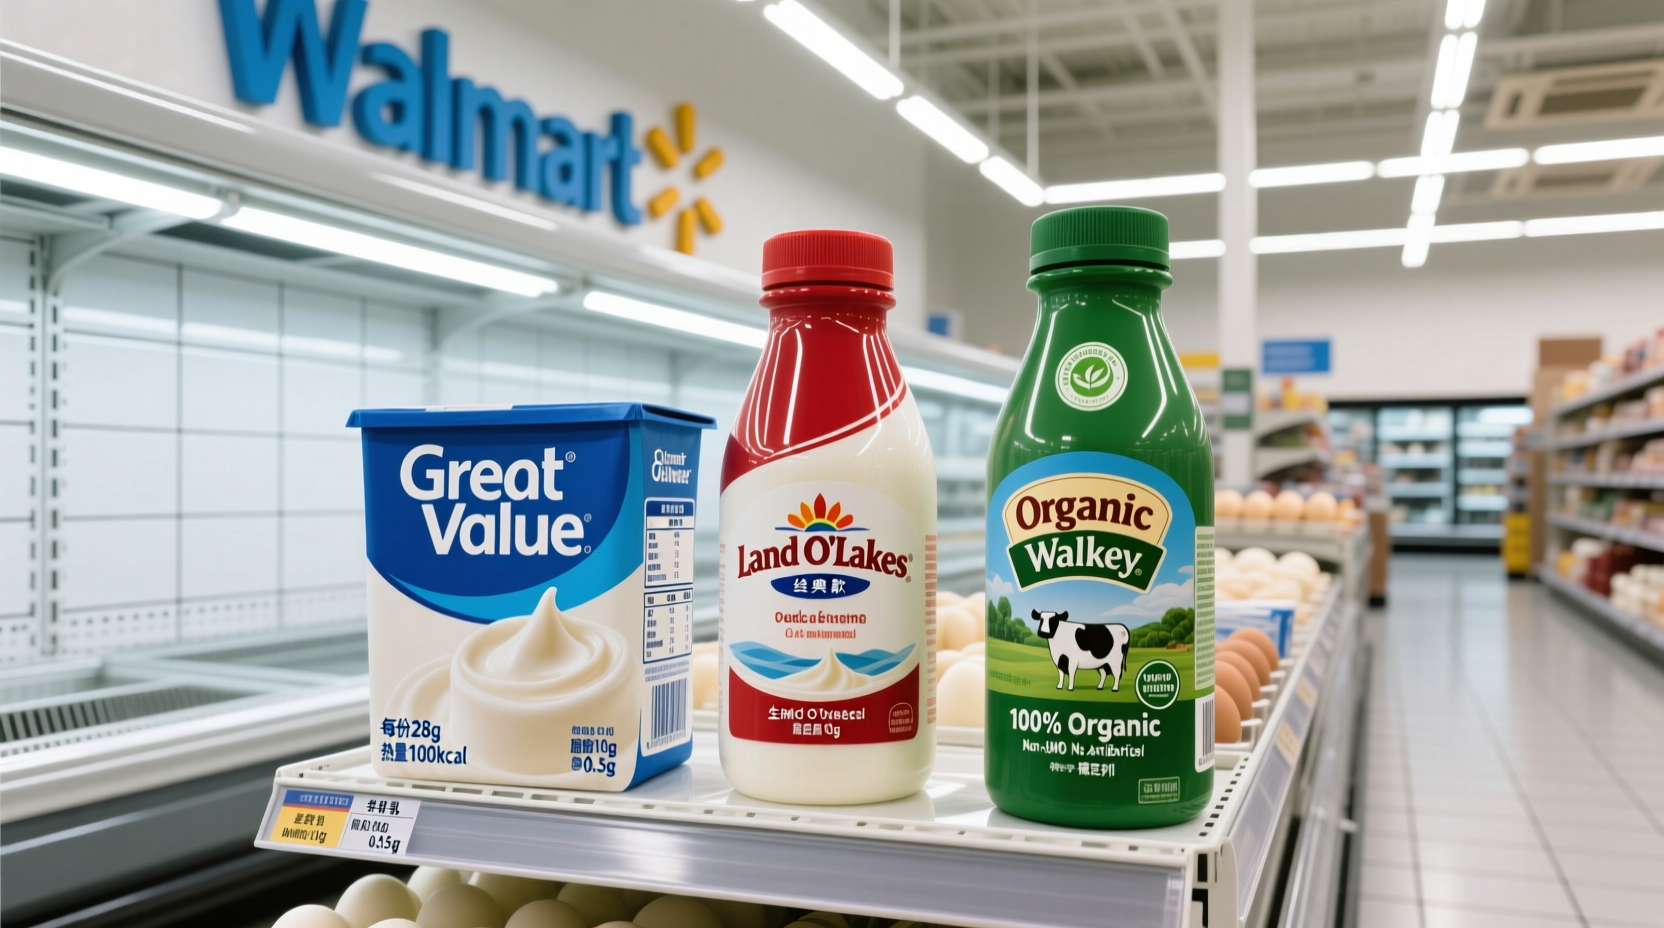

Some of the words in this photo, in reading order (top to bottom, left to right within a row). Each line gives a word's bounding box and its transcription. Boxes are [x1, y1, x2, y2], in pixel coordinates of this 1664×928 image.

[218, 0, 642, 226] Walmart
[400, 443, 564, 501] Great
[421, 501, 585, 557] Value
[1016, 493, 1154, 531] Organic
[738, 535, 800, 579] Land
[803, 535, 908, 579] O'Lakes
[1024, 535, 1143, 579] Walkey
[1009, 707, 1062, 735] 100%
[1068, 711, 1162, 743] Organic
